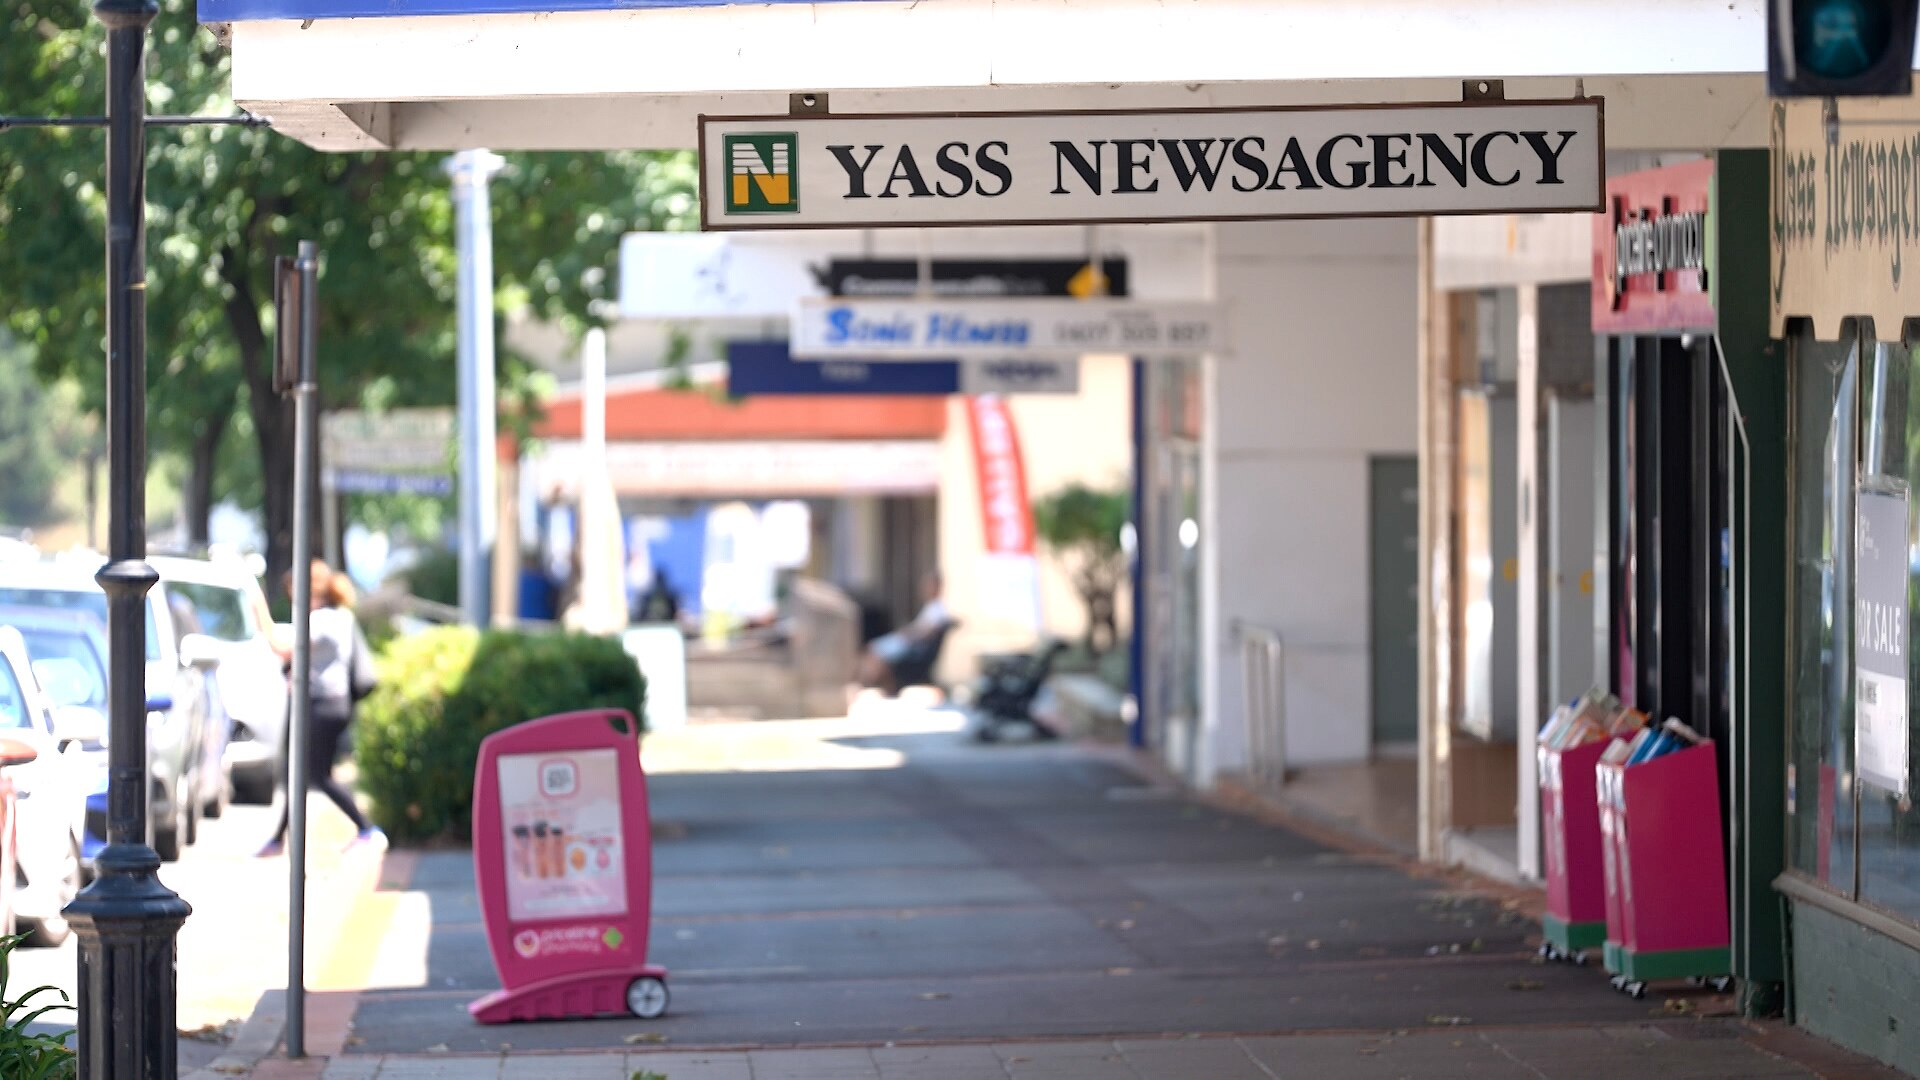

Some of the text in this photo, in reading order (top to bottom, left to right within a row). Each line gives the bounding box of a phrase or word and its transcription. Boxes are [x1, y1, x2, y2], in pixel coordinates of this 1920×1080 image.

[826, 130, 1578, 199] YASS NEWSAGENCY
[1874, 602, 1901, 656] SALE
